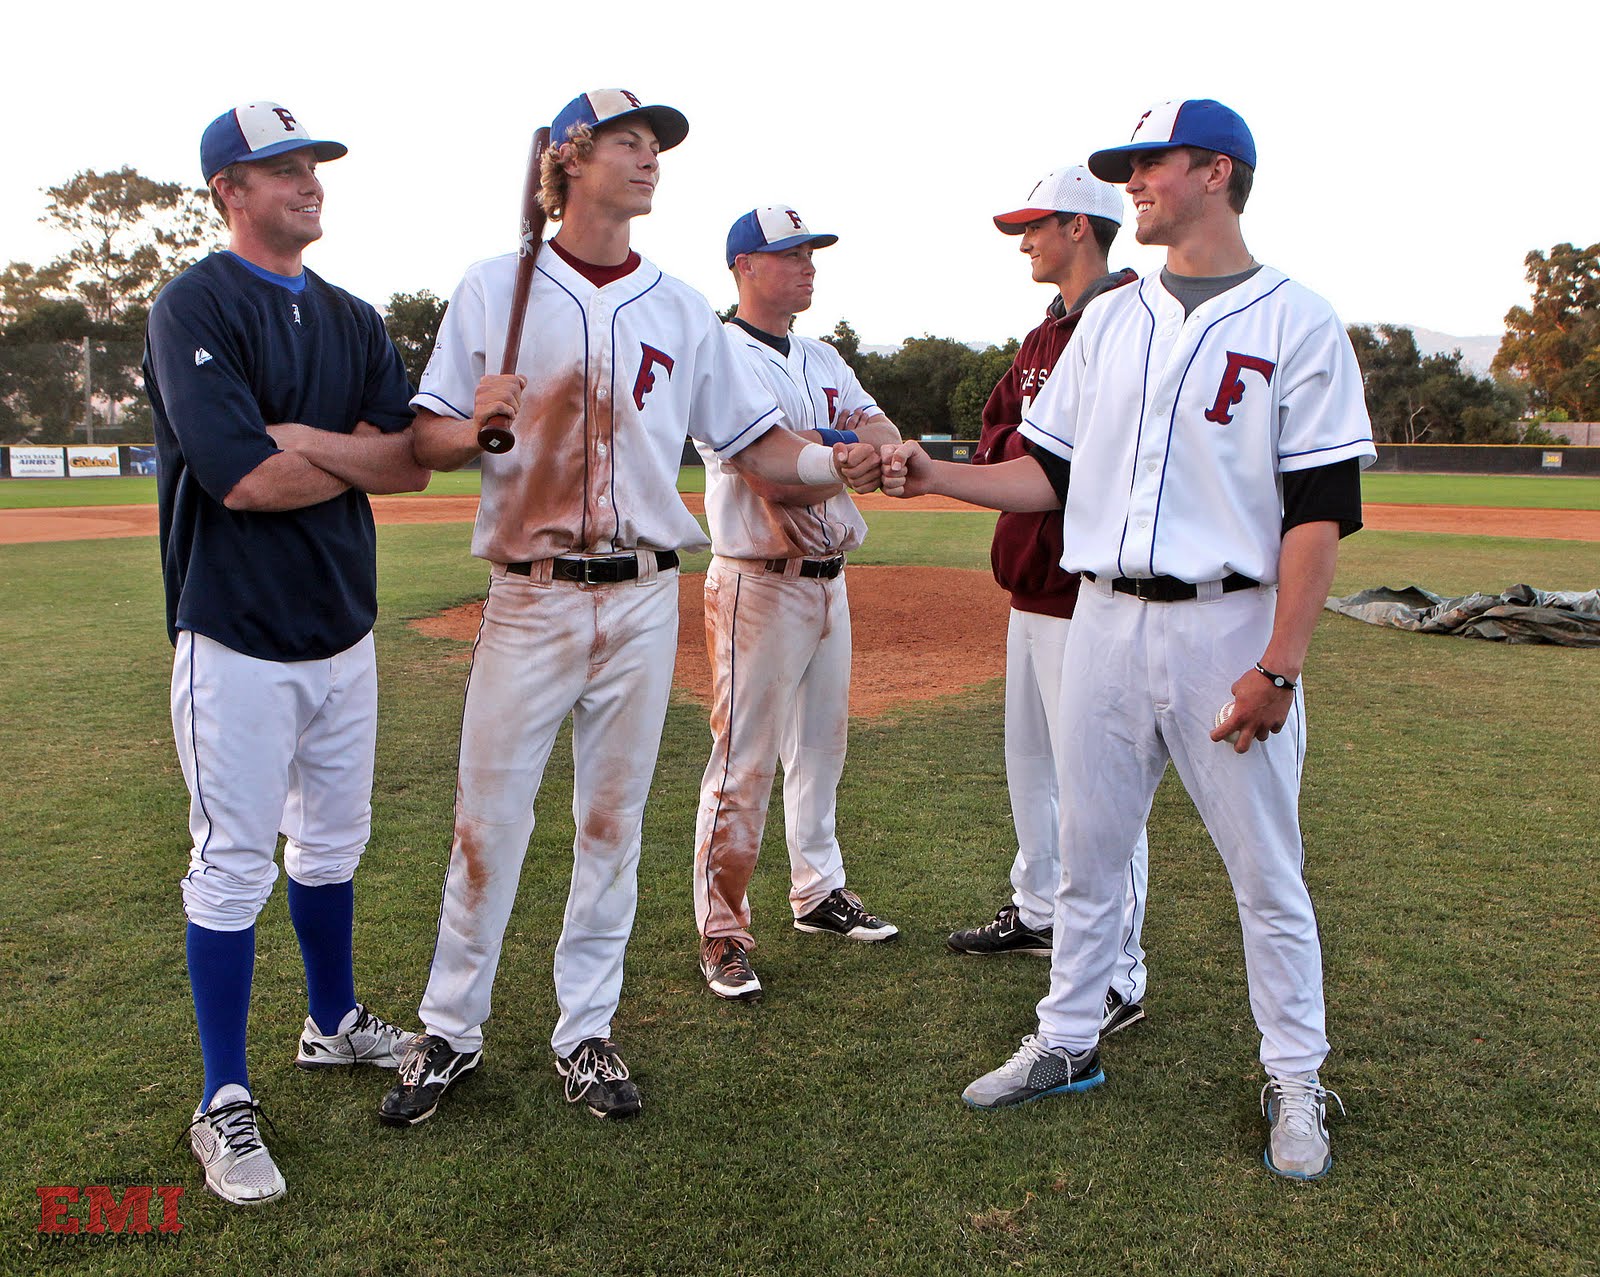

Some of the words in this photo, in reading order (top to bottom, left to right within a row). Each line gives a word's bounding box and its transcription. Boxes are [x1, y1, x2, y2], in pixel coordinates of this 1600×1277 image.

[272, 107, 297, 131] F
[785, 210, 802, 229] F
[632, 341, 675, 412] F
[1204, 350, 1277, 426] F
